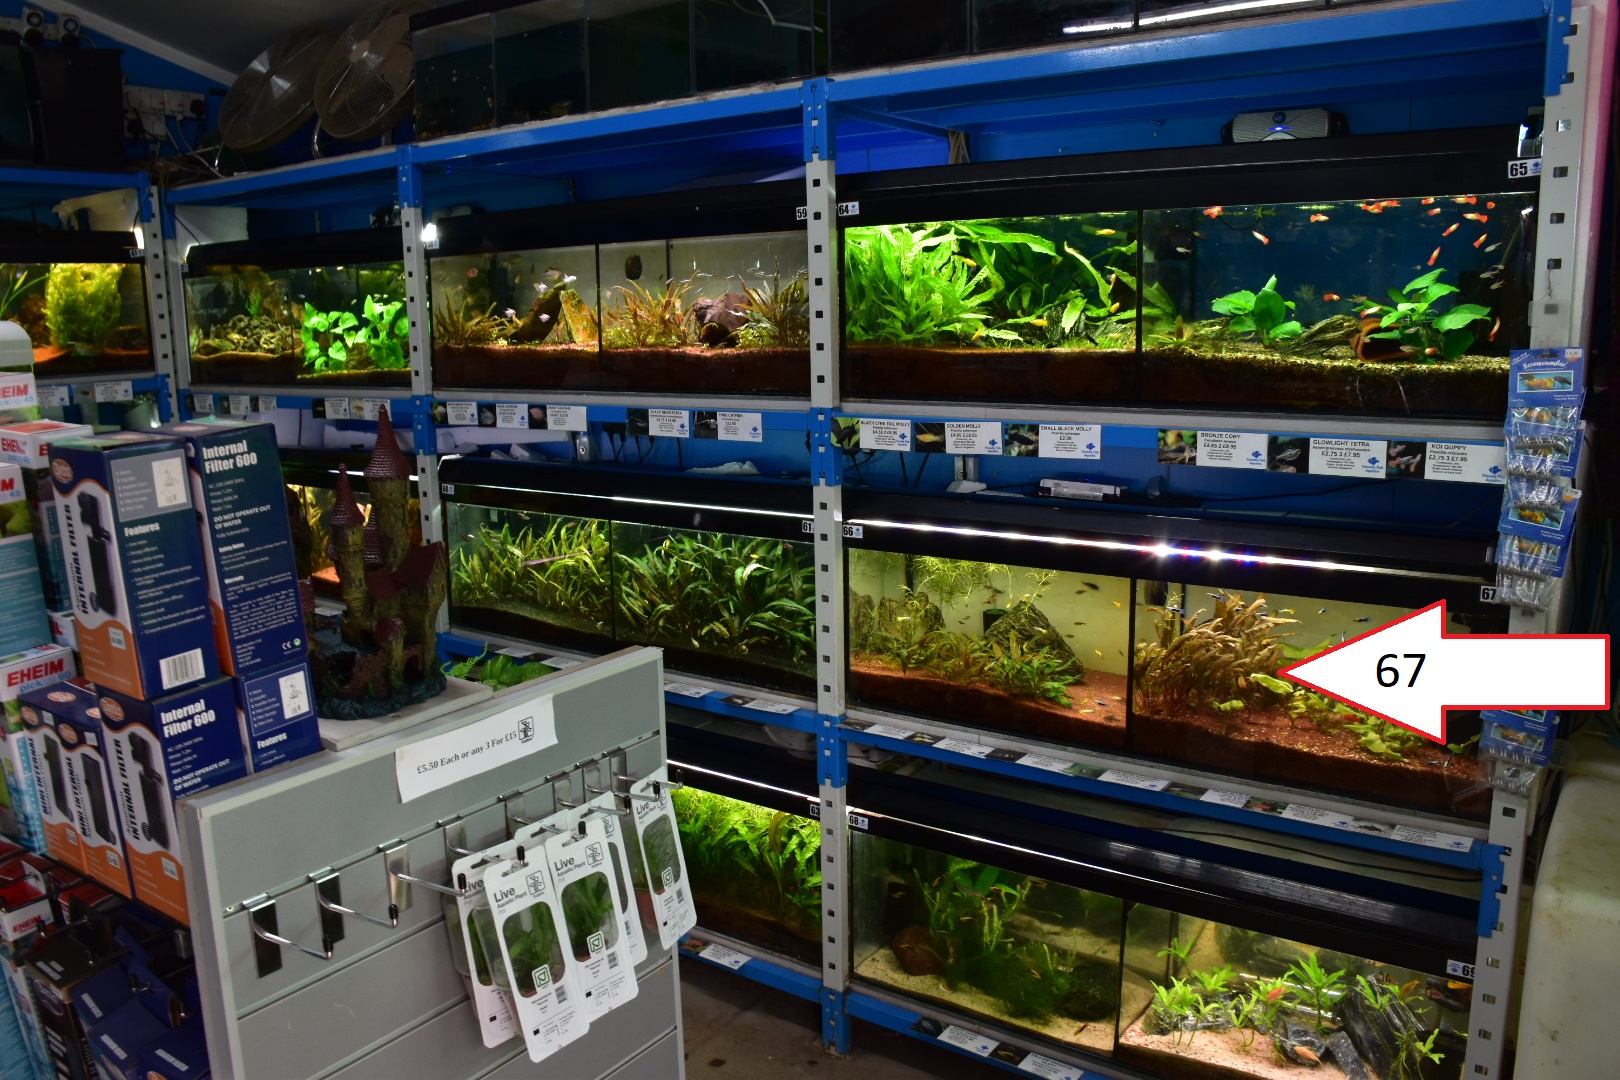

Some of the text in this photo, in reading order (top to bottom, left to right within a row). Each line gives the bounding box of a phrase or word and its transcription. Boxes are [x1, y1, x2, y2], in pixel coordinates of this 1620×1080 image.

[1510, 162, 1528, 176] 65
[797, 208, 807, 218] 59
[839, 204, 849, 214] 64
[0, 384, 28, 398] EIM
[202, 440, 248, 459] Internal
[204, 452, 258, 474] Filter 600
[222, 512, 234, 520] NOT
[234, 506, 258, 517] OPERATE
[124, 522, 160, 537] Features
[222, 518, 241, 528] WATER
[803, 522, 811, 531] 61
[844, 526, 853, 536] 66
[64, 504, 88, 614] INTERNAL FILTER
[1482, 588, 1496, 600] 67
[8, 658, 64, 687] EHEIM
[58, 671, 71, 680] 60
[20, 680, 43, 693] pick
[160, 698, 206, 724] Internal
[163, 710, 216, 738] Filter 600
[257, 732, 287, 749] Features
[417, 731, 517, 774] £5.50 Each or any 3 For £15
[28, 738, 43, 788] INTERNAL
[173, 758, 229, 784] DO NOT OPERATE OUT
[65, 757, 82, 808] INTERNAL
[114, 738, 140, 840] INTERNAL FILTER
[174, 776, 201, 792] OF WATER
[38, 790, 48, 814] MINI
[636, 802, 649, 815] Live
[811, 806, 820, 815] 63
[77, 810, 88, 837] MINI
[850, 816, 858, 825] 68
[554, 857, 574, 871] Live
[557, 861, 586, 877] Aquatic Plant
[494, 887, 515, 903] Live
[497, 891, 527, 909] Aquatic Plant
[13, 915, 41, 932] EHEIM
